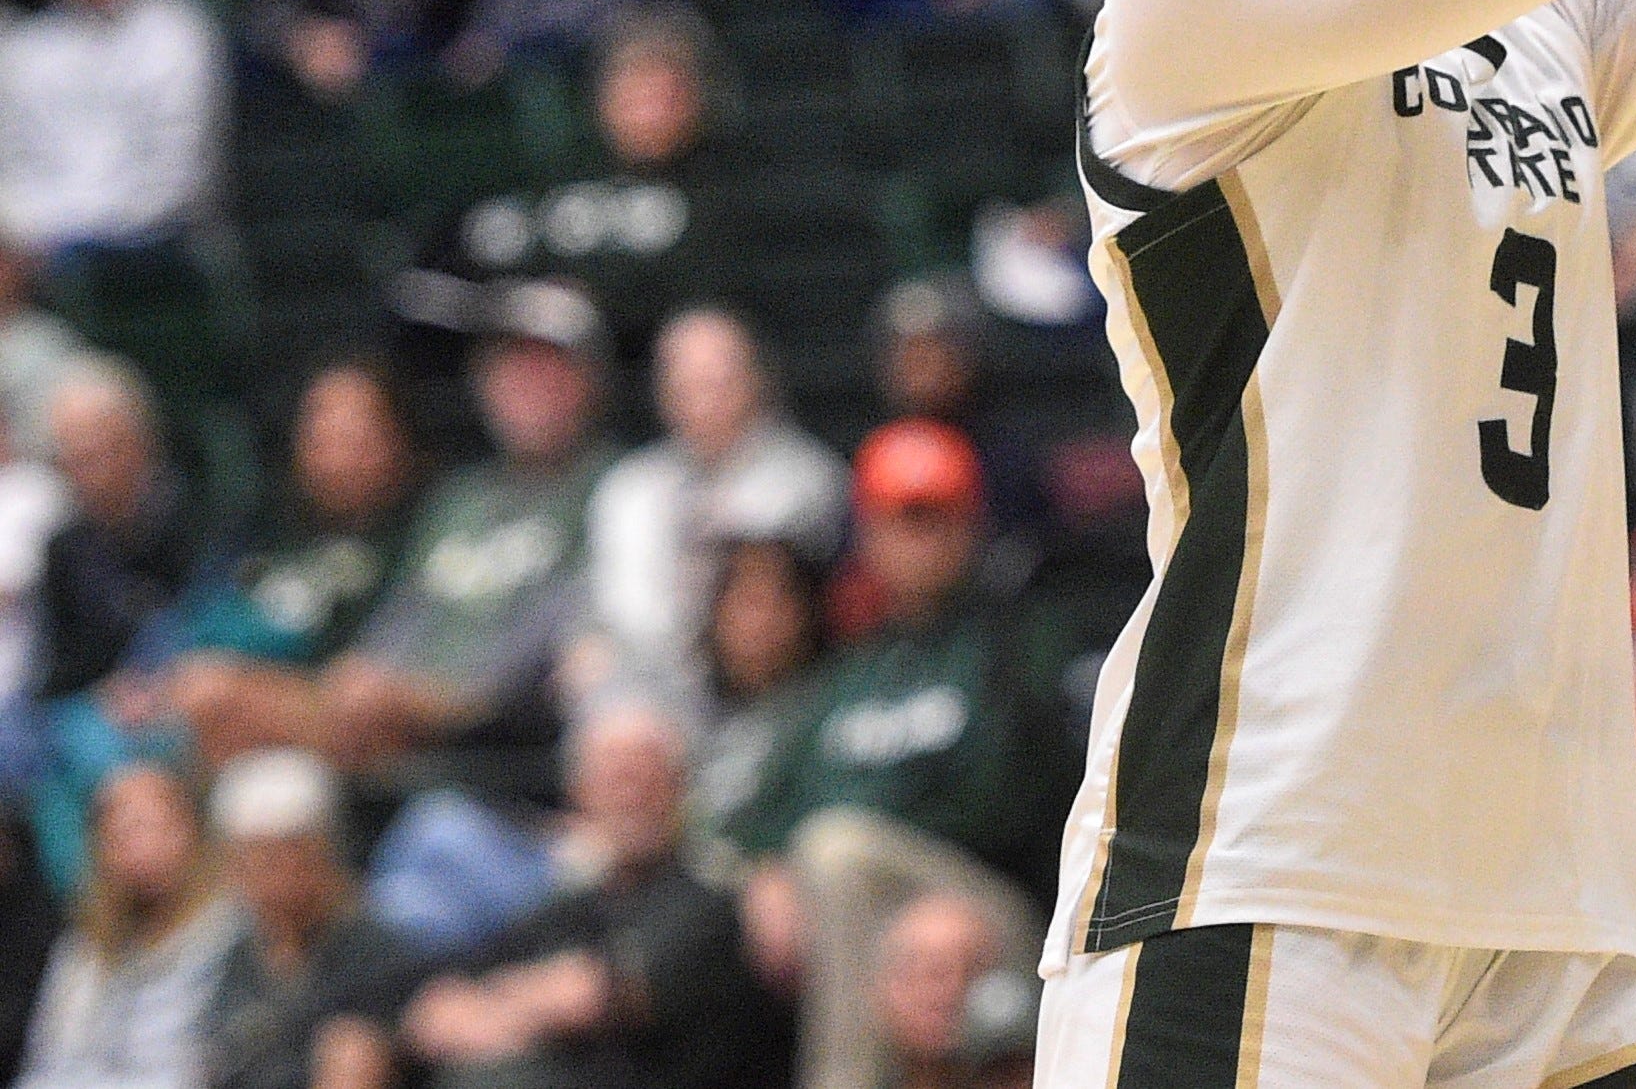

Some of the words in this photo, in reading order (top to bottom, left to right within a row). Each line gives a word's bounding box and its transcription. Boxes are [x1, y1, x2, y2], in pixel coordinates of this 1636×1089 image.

[1391, 64, 1598, 150] CORAO
[1468, 144, 1581, 204] TATE
[1478, 227, 1557, 510] 3
